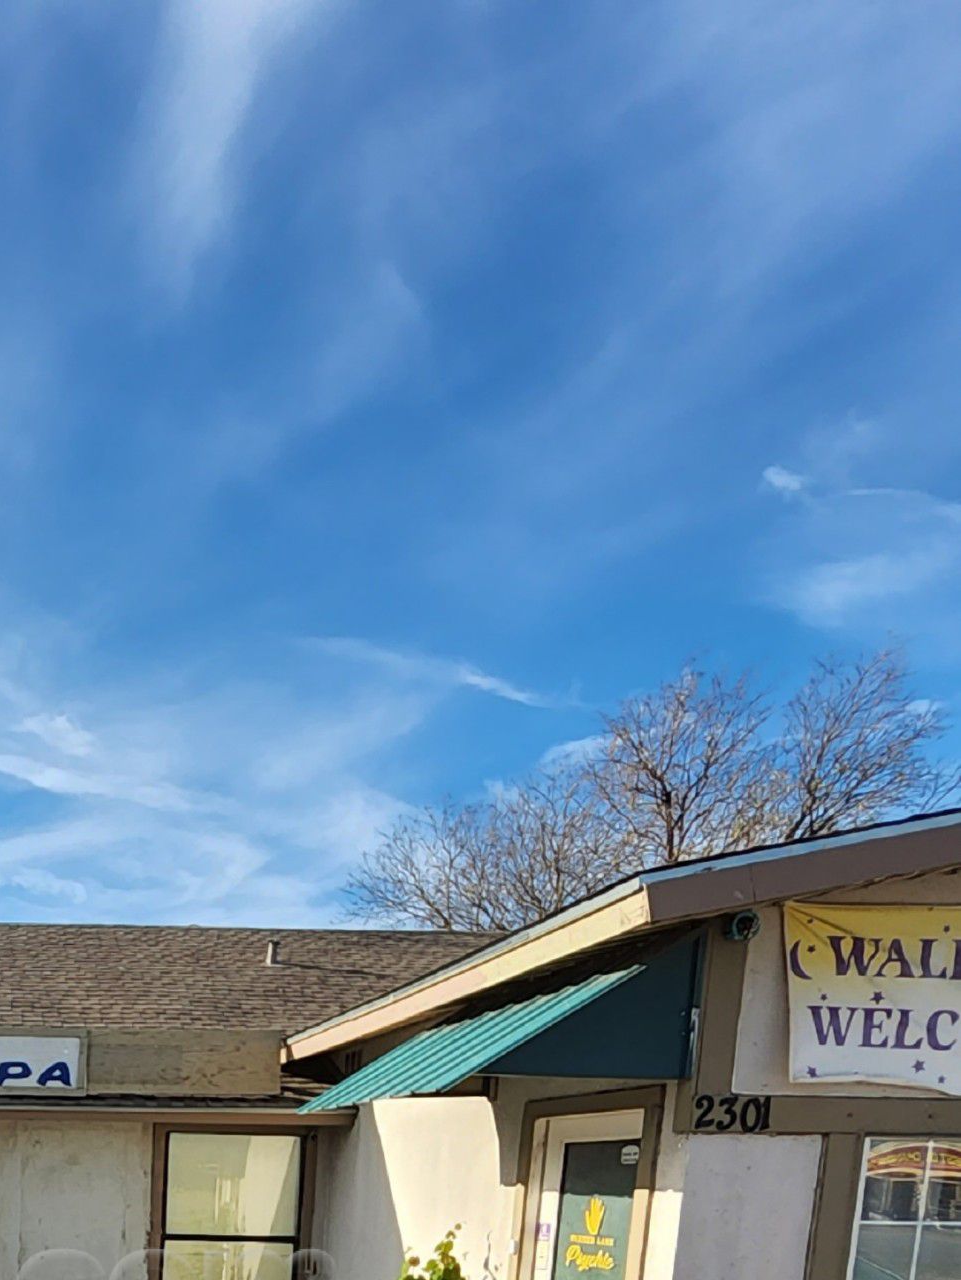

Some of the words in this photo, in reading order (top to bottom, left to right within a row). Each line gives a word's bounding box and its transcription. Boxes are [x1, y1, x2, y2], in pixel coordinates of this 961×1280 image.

[827, 936, 961, 979] WAL
[807, 1005, 960, 1051] WELC
[694, 1094, 771, 1132] 2301
